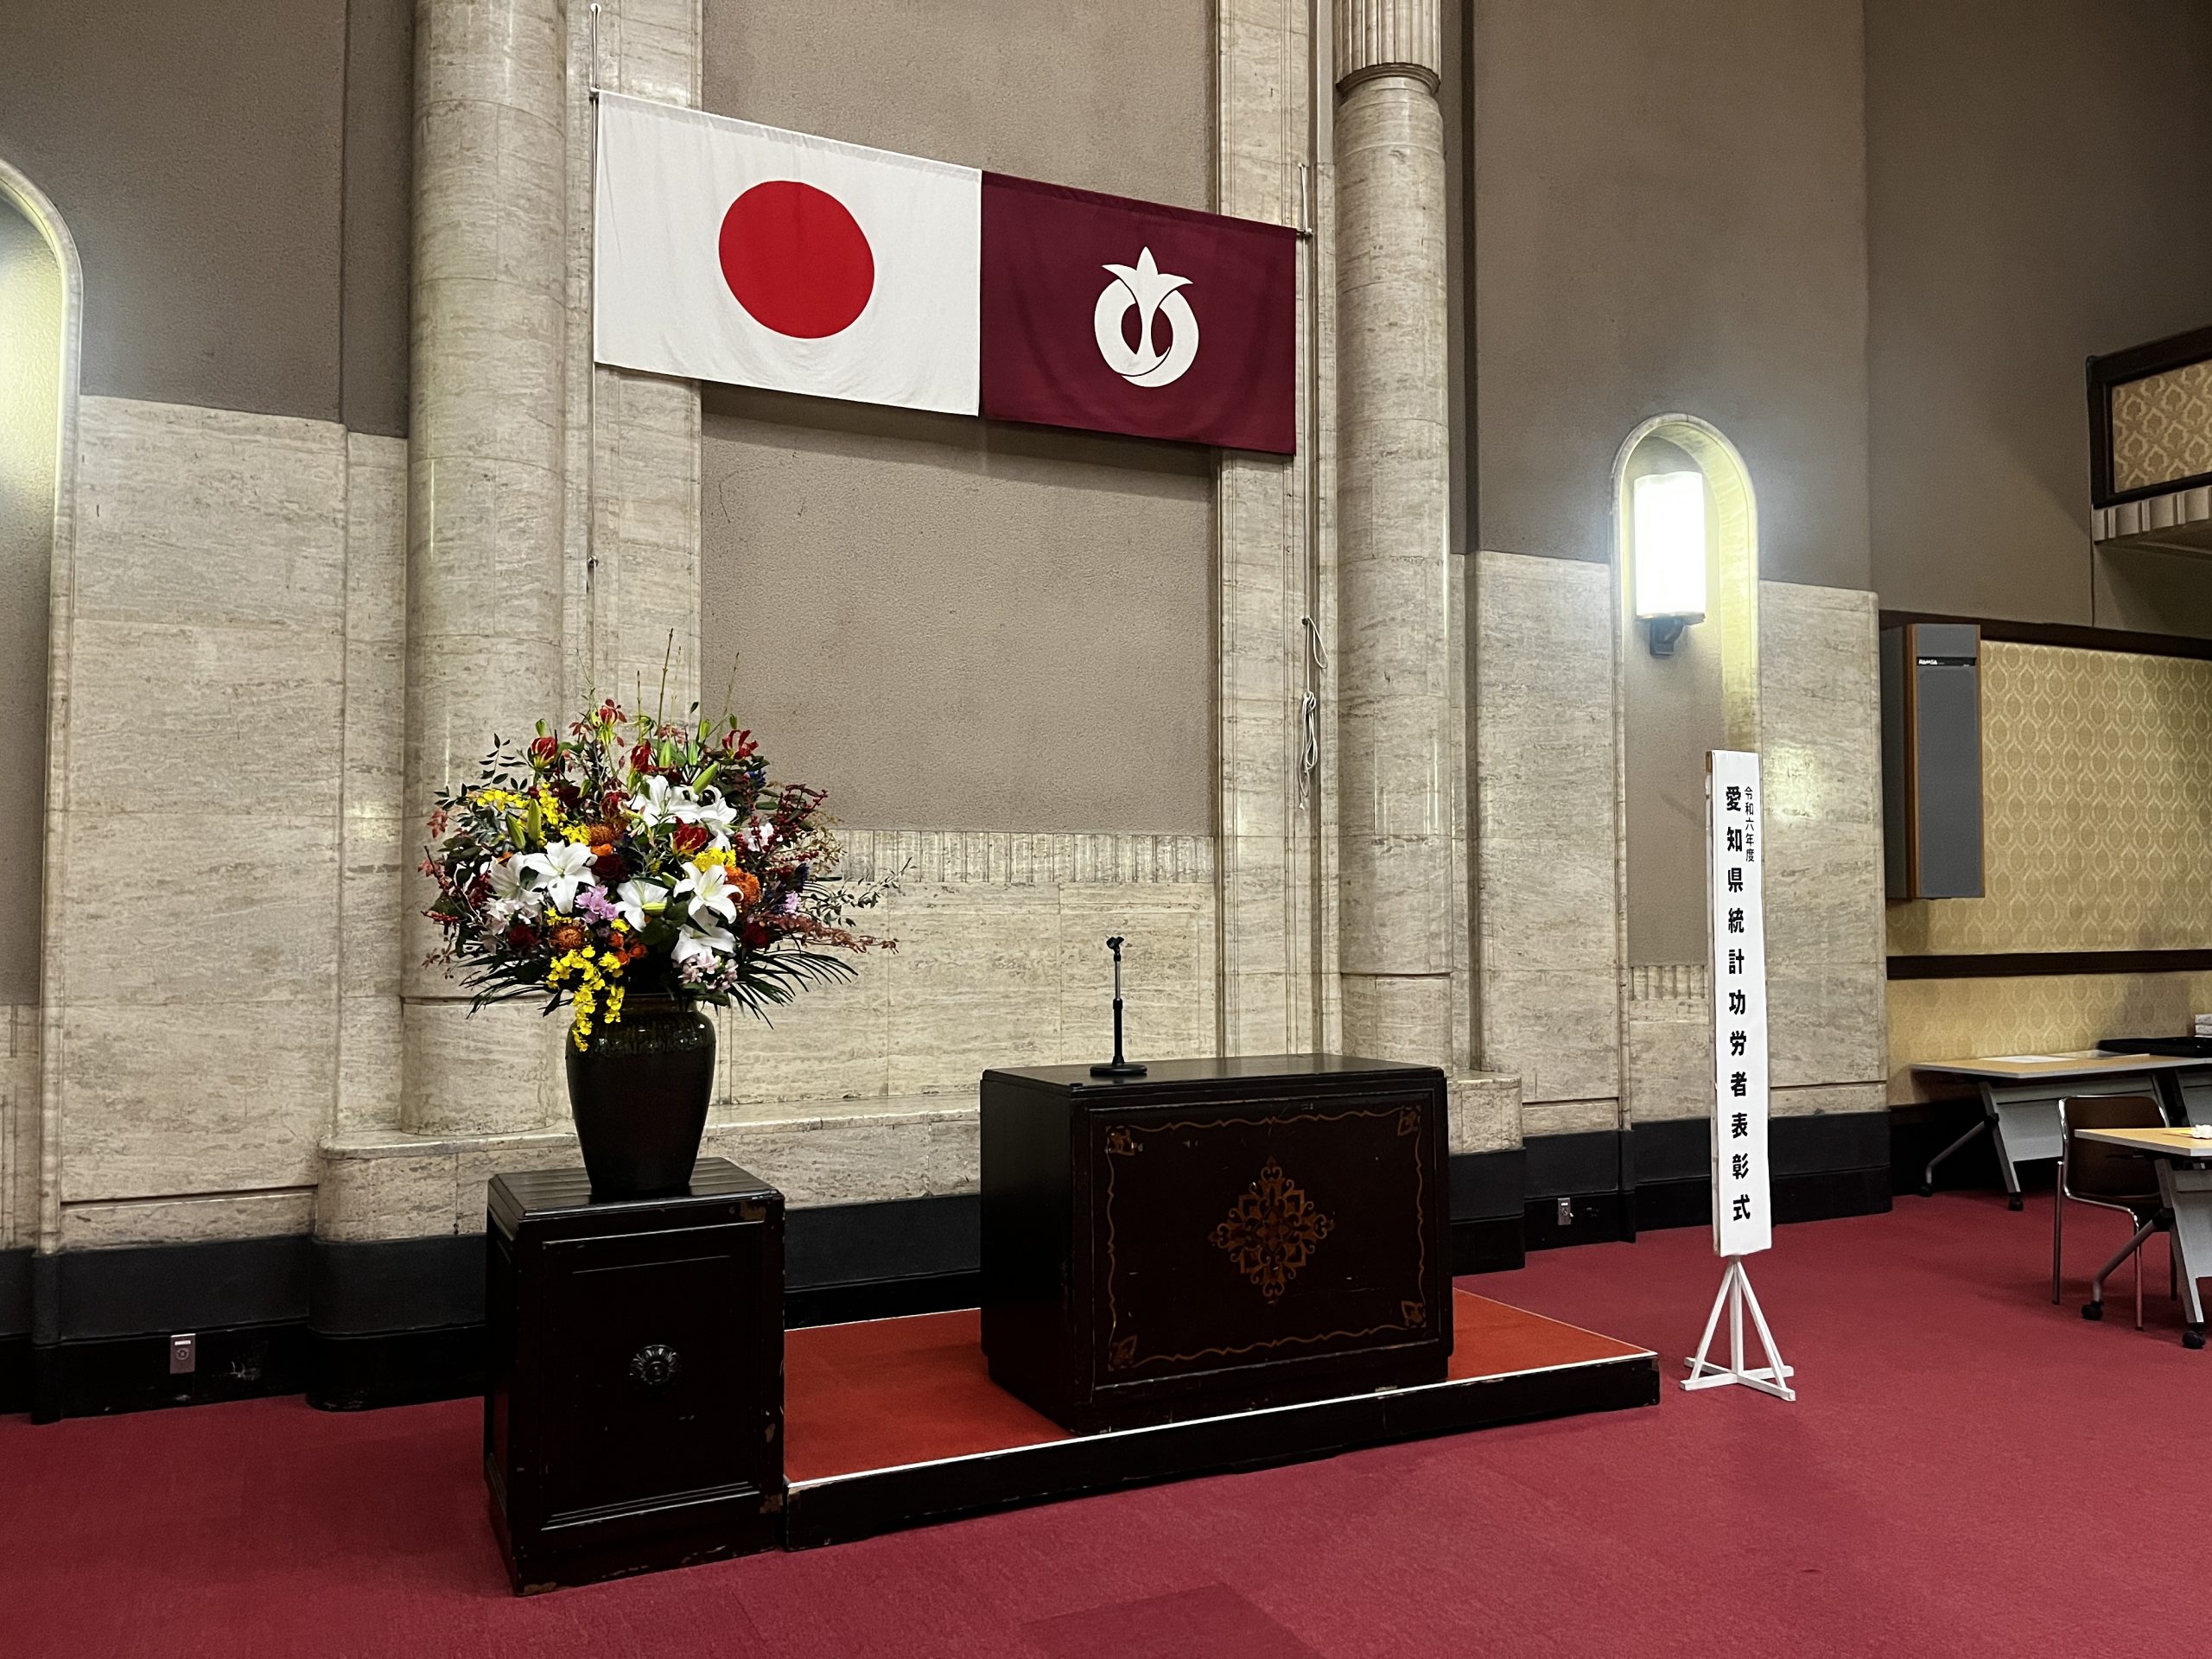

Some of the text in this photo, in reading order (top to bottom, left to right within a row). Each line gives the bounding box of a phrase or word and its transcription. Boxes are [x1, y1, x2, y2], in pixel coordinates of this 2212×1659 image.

[1744, 785, 1755, 862] 令和六年度
[1726, 785, 1751, 1222] 愛知県統計功労者表彰式
